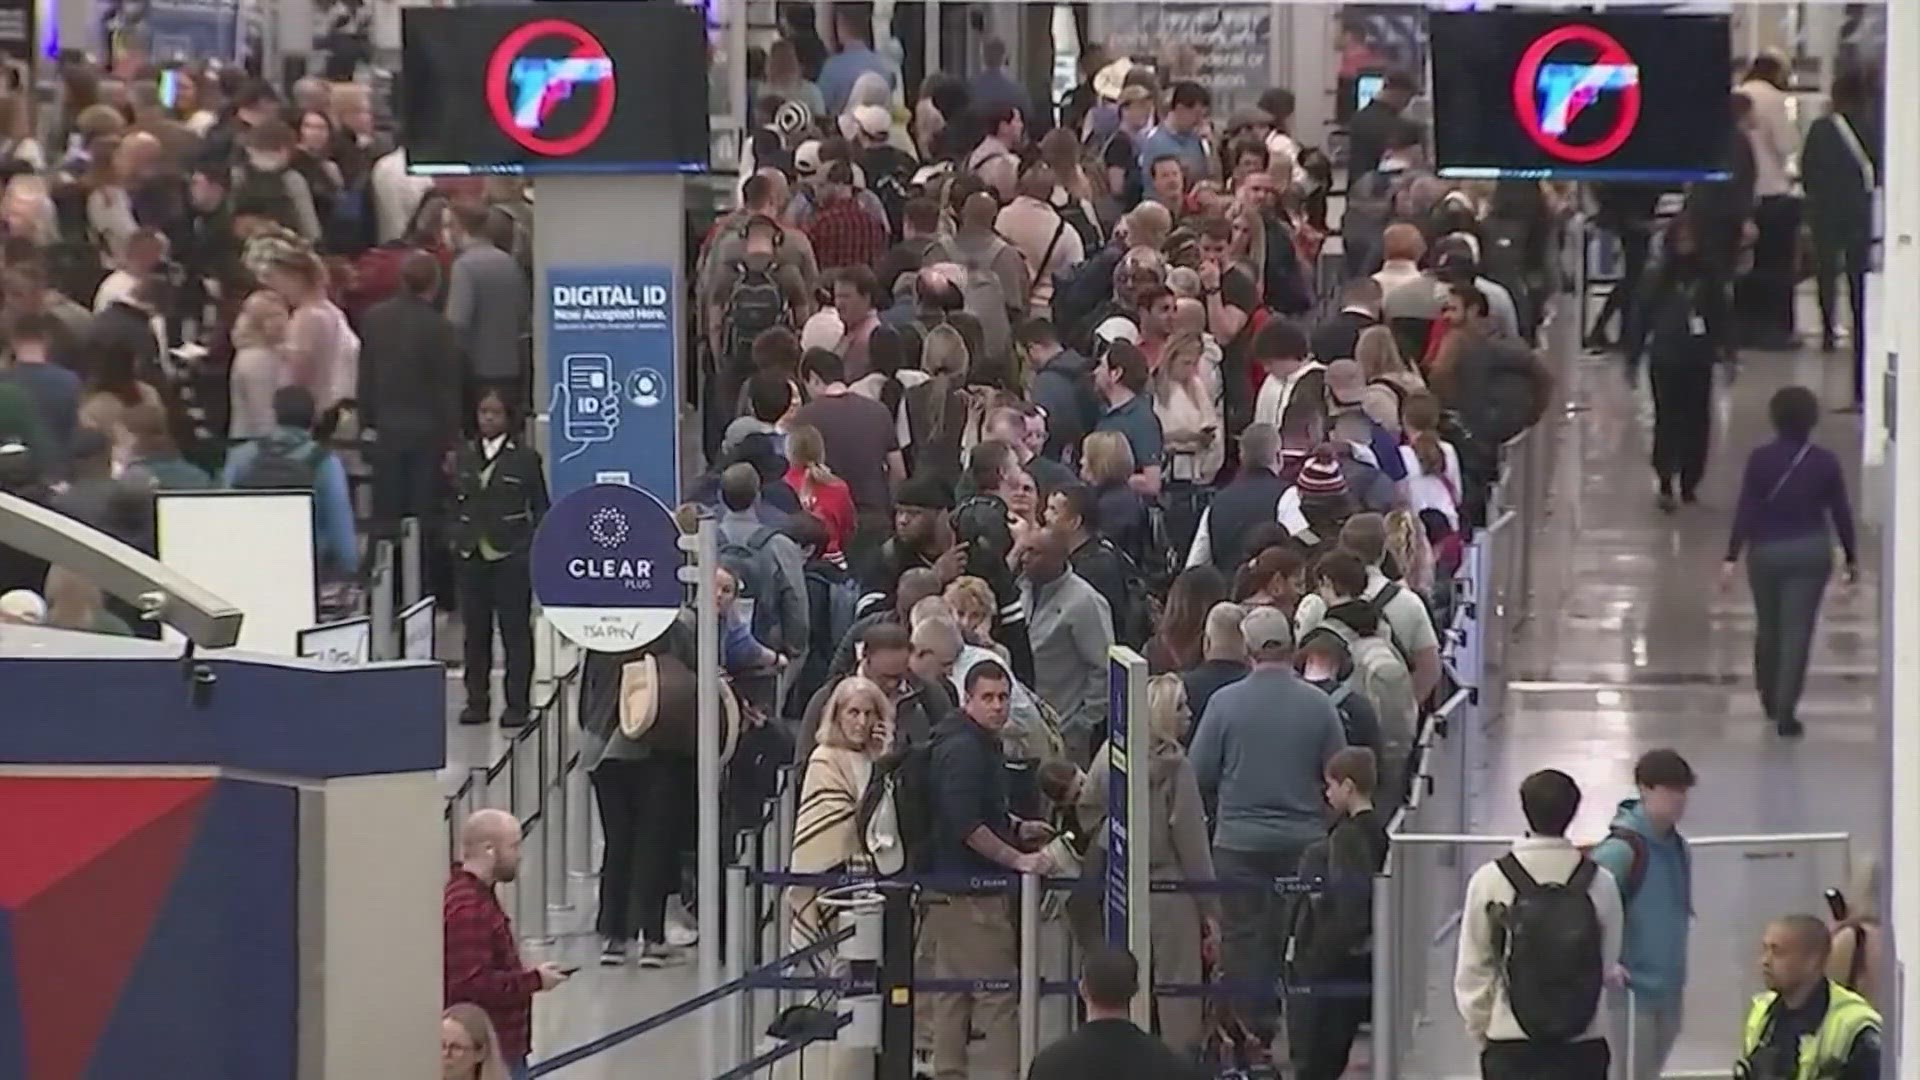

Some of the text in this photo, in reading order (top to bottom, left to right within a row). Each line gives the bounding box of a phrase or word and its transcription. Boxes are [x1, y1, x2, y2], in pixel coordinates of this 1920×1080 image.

[553, 285, 667, 307] DIGITAL ID
[553, 308, 581, 320] Now
[583, 308, 635, 322] Accepted
[577, 397, 599, 414] ID
[568, 558, 651, 578] CLEAR
[624, 579, 651, 590] PLUS
